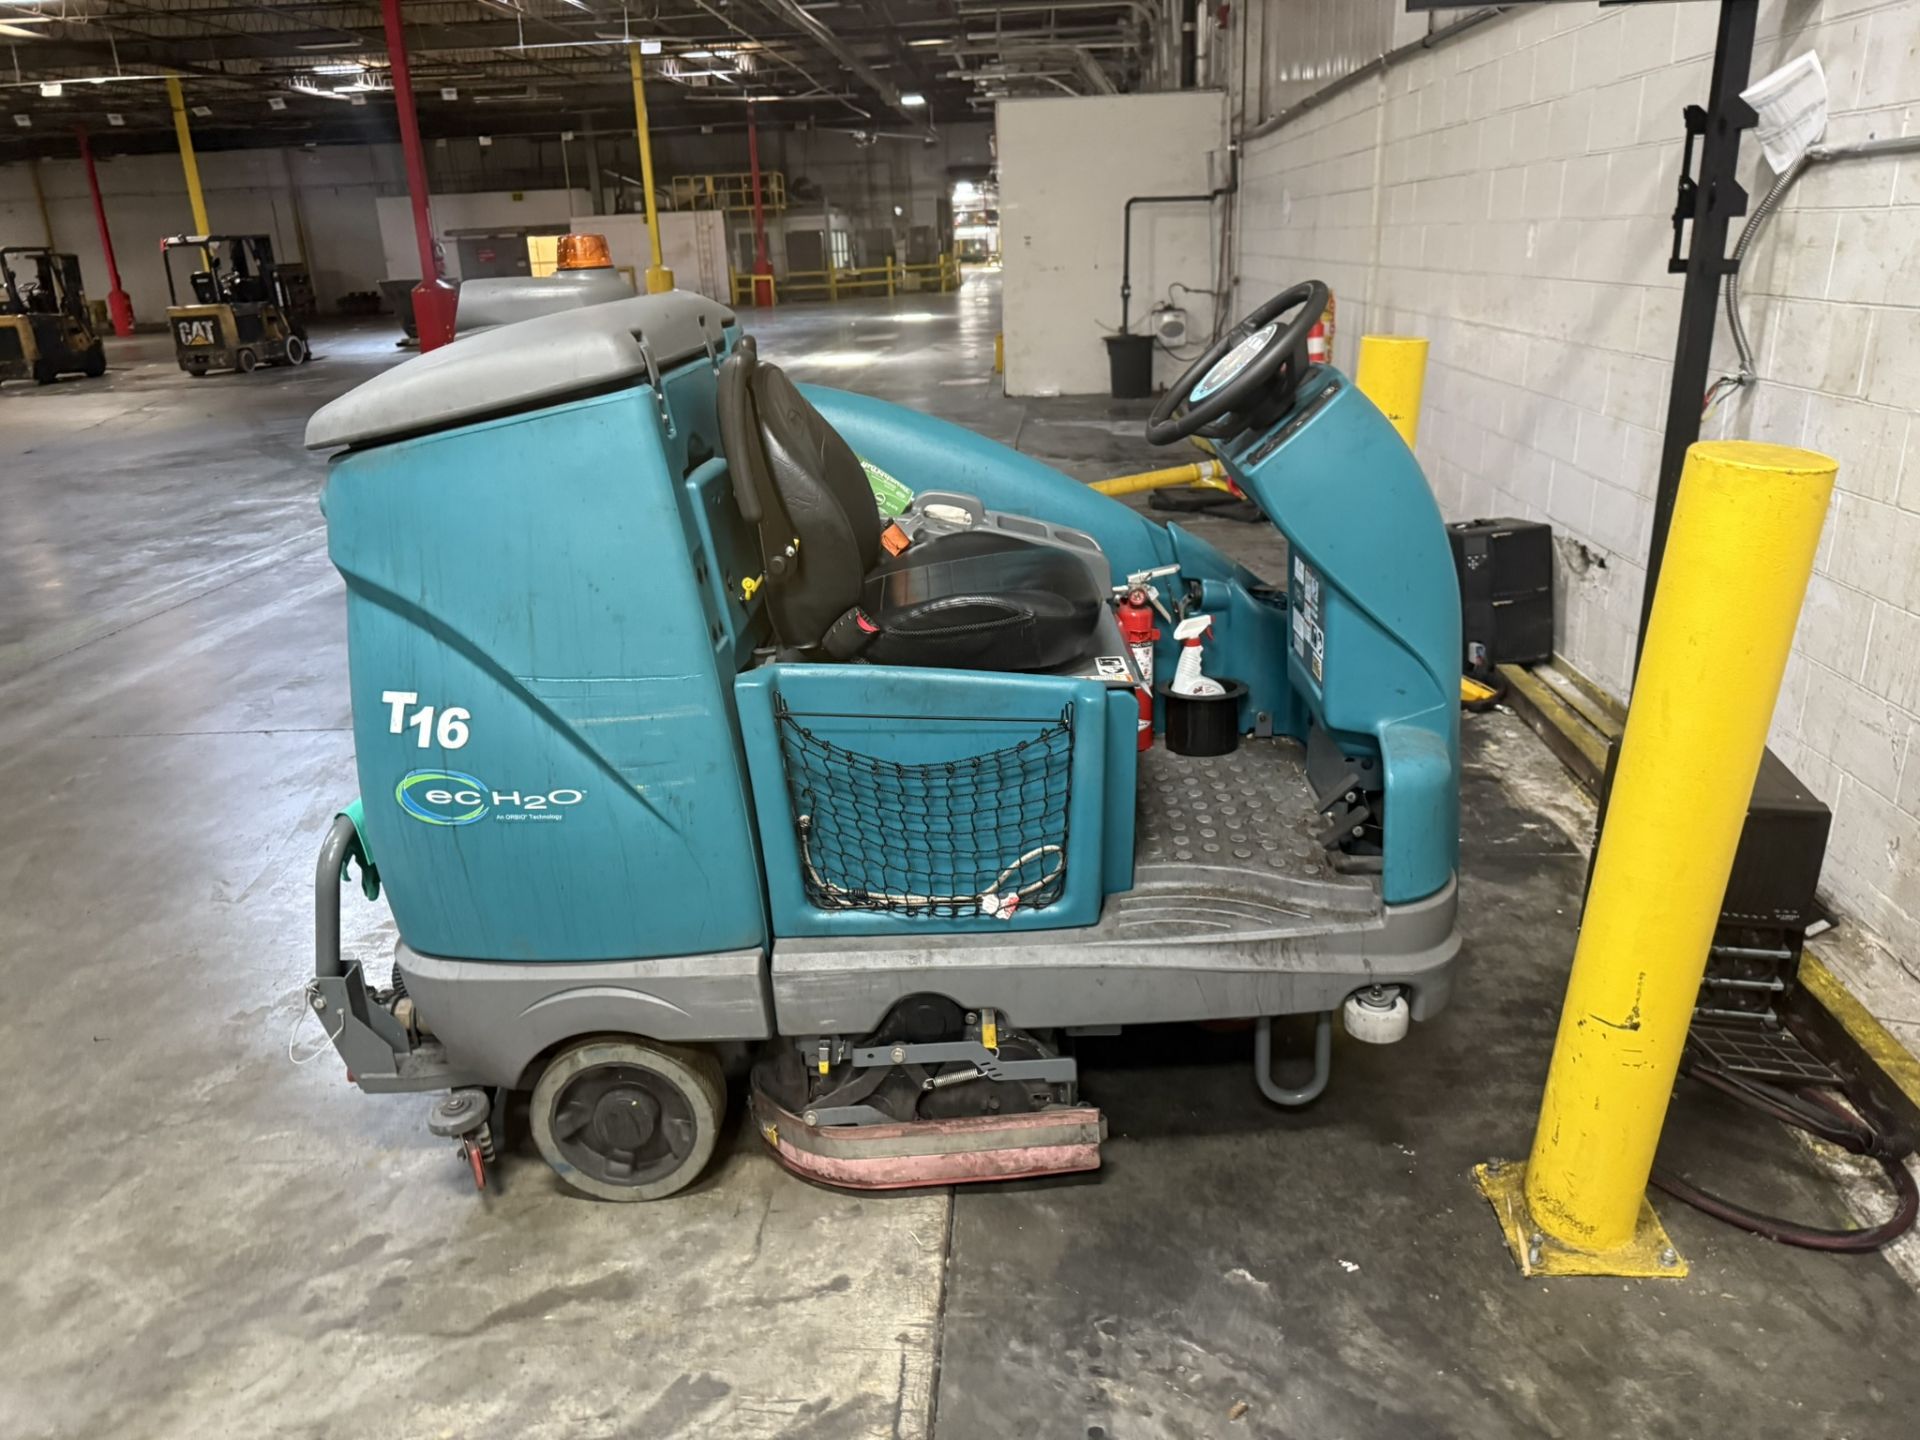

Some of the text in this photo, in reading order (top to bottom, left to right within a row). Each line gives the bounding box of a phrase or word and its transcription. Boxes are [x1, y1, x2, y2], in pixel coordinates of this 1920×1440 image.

[178, 320, 215, 346] CAT
[381, 690, 471, 749] T16
[528, 813, 562, 821] Technology
